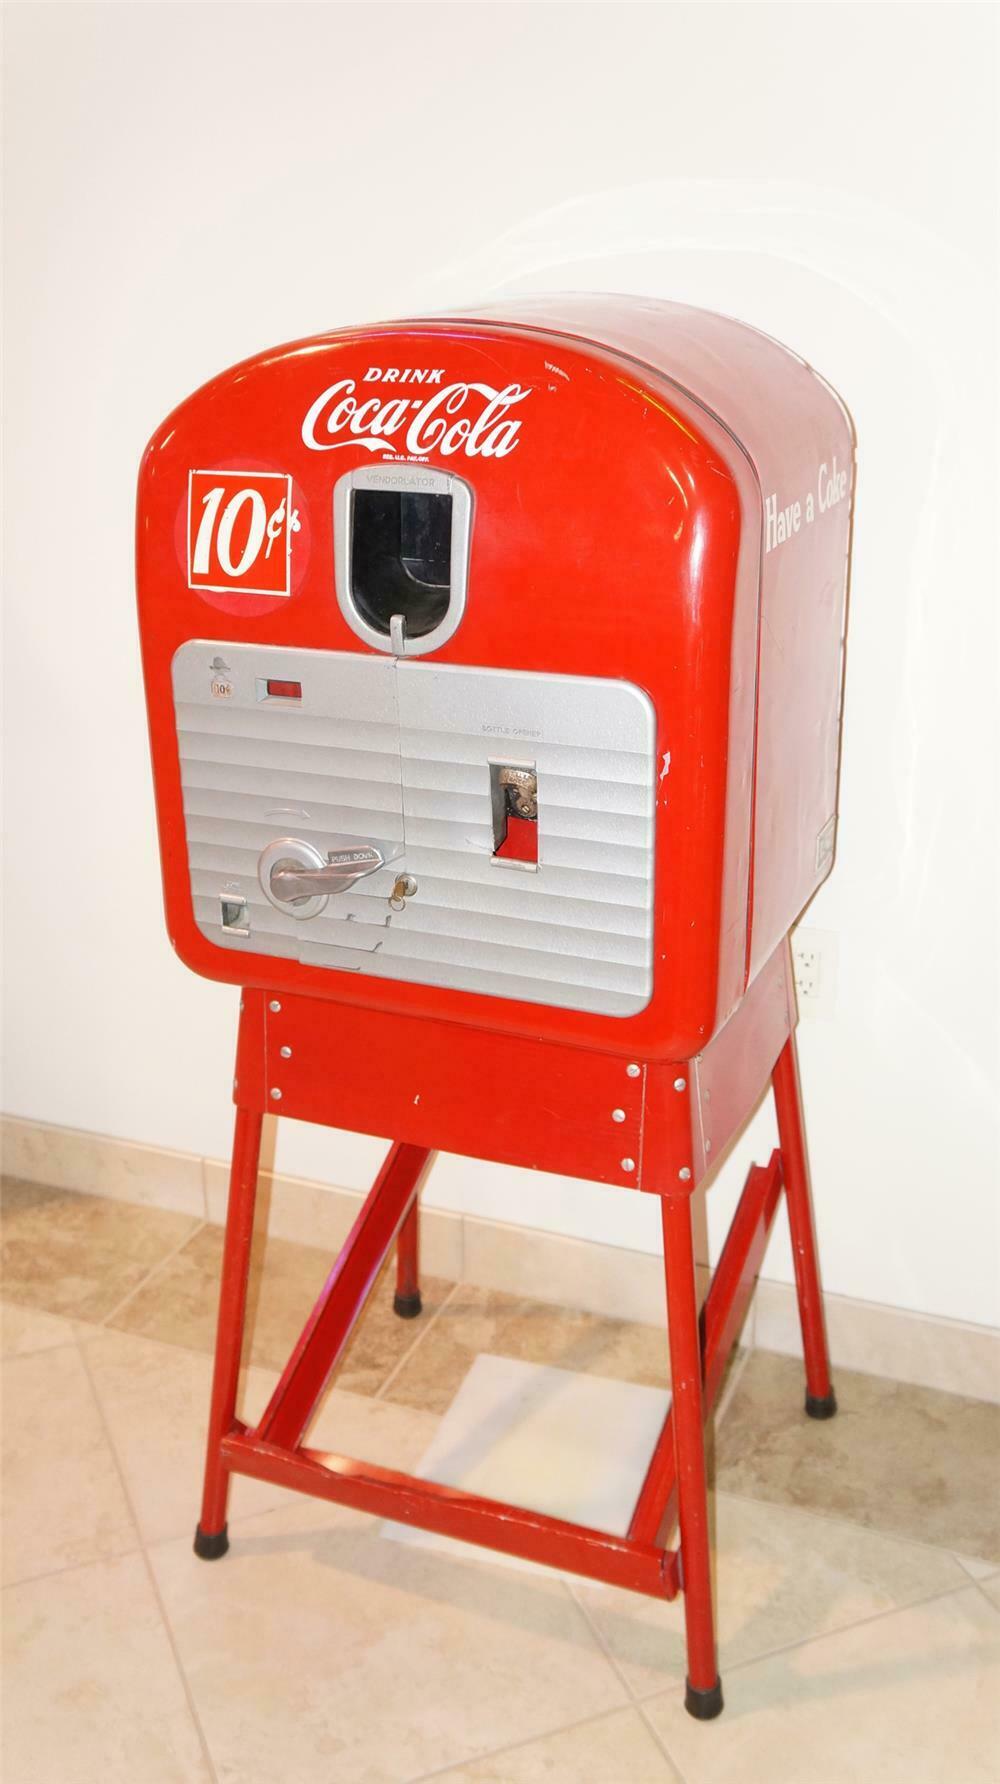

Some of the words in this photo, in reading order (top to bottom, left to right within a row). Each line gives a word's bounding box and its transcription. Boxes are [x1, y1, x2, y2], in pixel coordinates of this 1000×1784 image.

[362, 367, 446, 384] DRINK
[301, 379, 532, 458] Coca-Cola
[192, 487, 286, 577] 10¢
[765, 492, 801, 554] Have
[806, 492, 815, 523] a
[818, 456, 847, 513] Coke
[330, 853, 351, 863] PUSH
